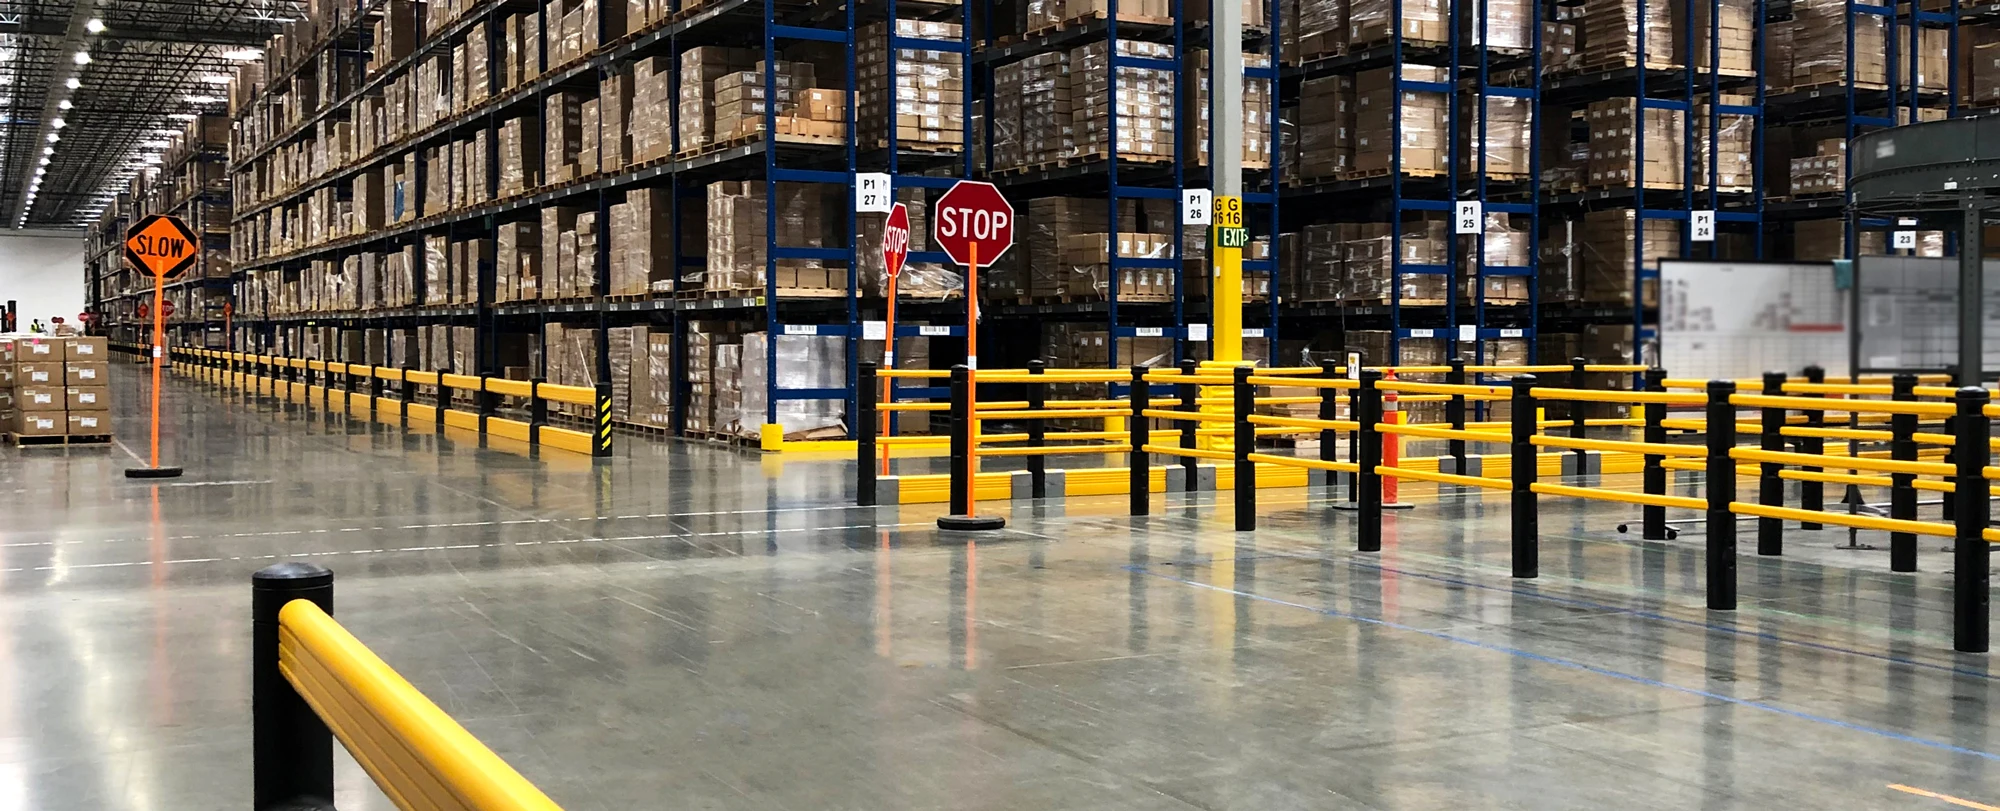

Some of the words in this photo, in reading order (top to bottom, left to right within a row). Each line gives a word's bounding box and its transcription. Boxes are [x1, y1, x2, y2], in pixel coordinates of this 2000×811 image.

[864, 179, 875, 190] P1
[864, 195, 876, 205] 27
[1190, 195, 1201, 204] P1
[1215, 198, 1222, 211] G
[1228, 198, 1238, 211] G
[1190, 209, 1202, 218] 26
[1463, 206, 1473, 215] P1
[941, 206, 1008, 240] STOP
[1214, 212, 1224, 224] 16
[1226, 212, 1240, 224] 16
[1463, 219, 1474, 228] 25
[1697, 215, 1708, 224] P1
[1223, 227, 1245, 246] EXIT
[1697, 227, 1708, 236] 24
[885, 225, 907, 254] STOP
[1900, 235, 1911, 244] 23
[136, 235, 185, 258] SLOW
